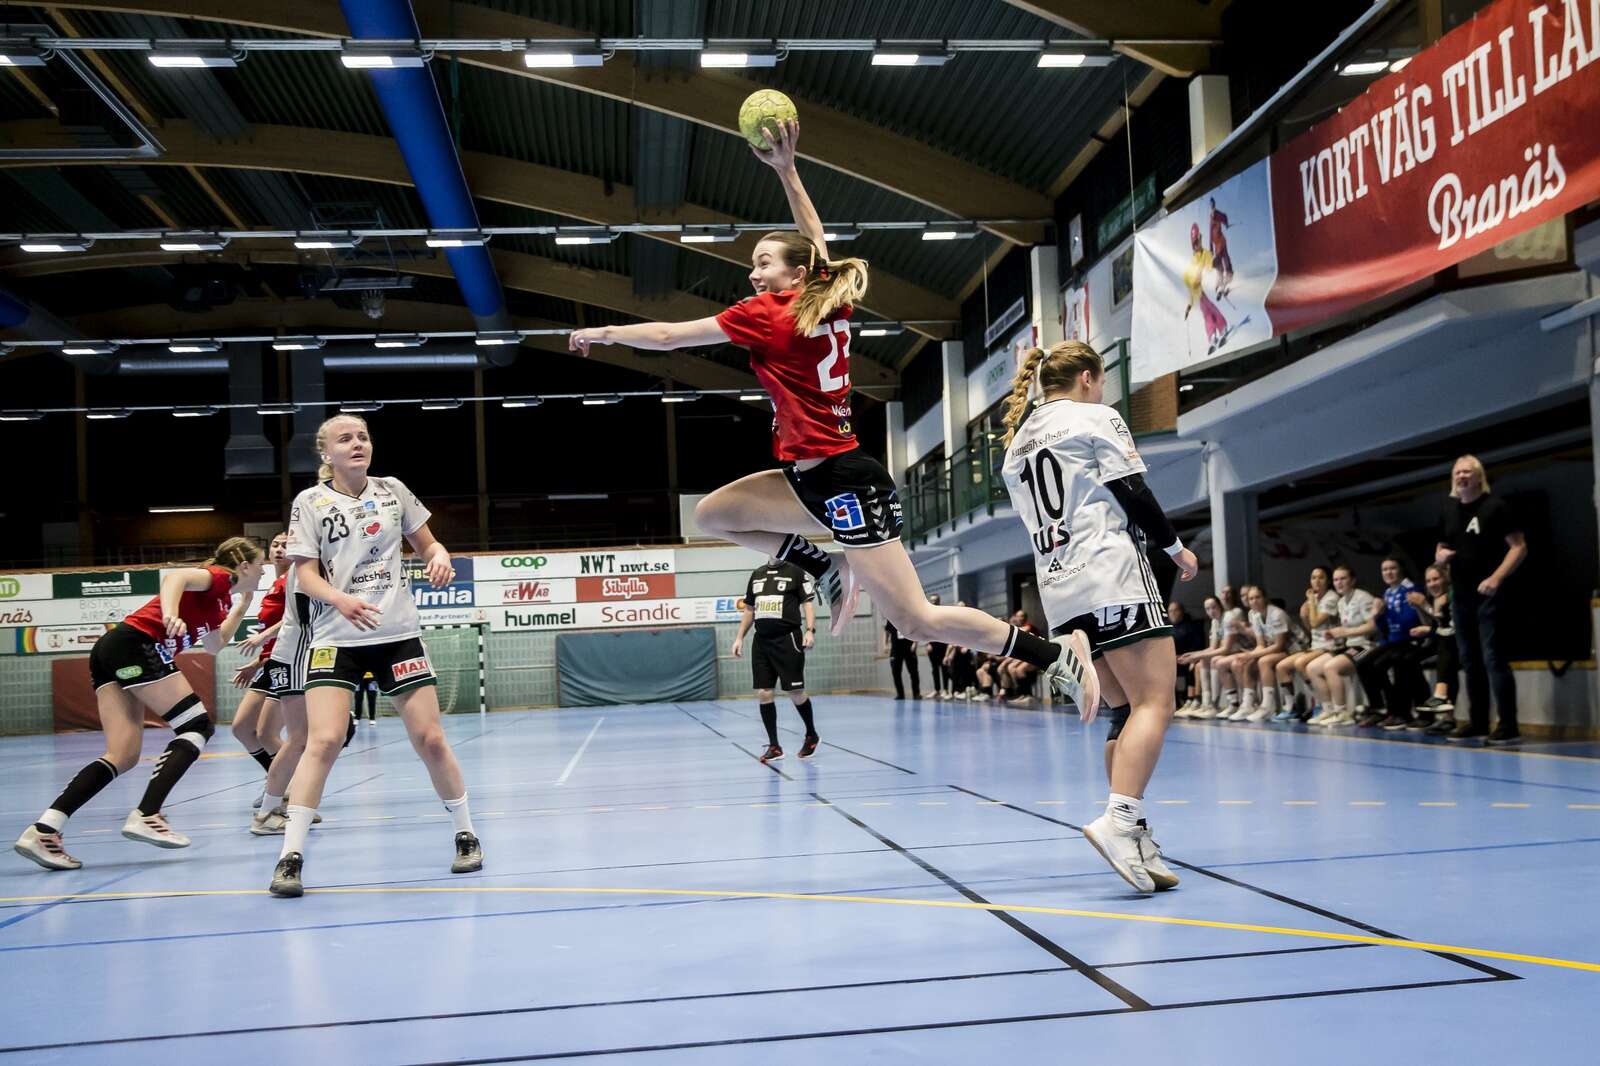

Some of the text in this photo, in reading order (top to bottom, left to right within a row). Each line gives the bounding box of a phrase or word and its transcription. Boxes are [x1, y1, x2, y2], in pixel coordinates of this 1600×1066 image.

[1300, 123, 1370, 226] KORT
[1370, 83, 1437, 184] VÄG
[1442, 26, 1527, 147] TILL
[1427, 142, 1566, 250] Branäs
[1020, 448, 1065, 528] 10
[321, 513, 350, 544] 23
[1466, 516, 1480, 535] A
[501, 556, 548, 570] coop
[580, 554, 670, 574] NWT nwt.se
[415, 586, 472, 606] lmia
[503, 581, 550, 601] KEWAB
[604, 578, 647, 598] Sibylla
[505, 607, 576, 627] hummel
[601, 603, 681, 623] Scandic
